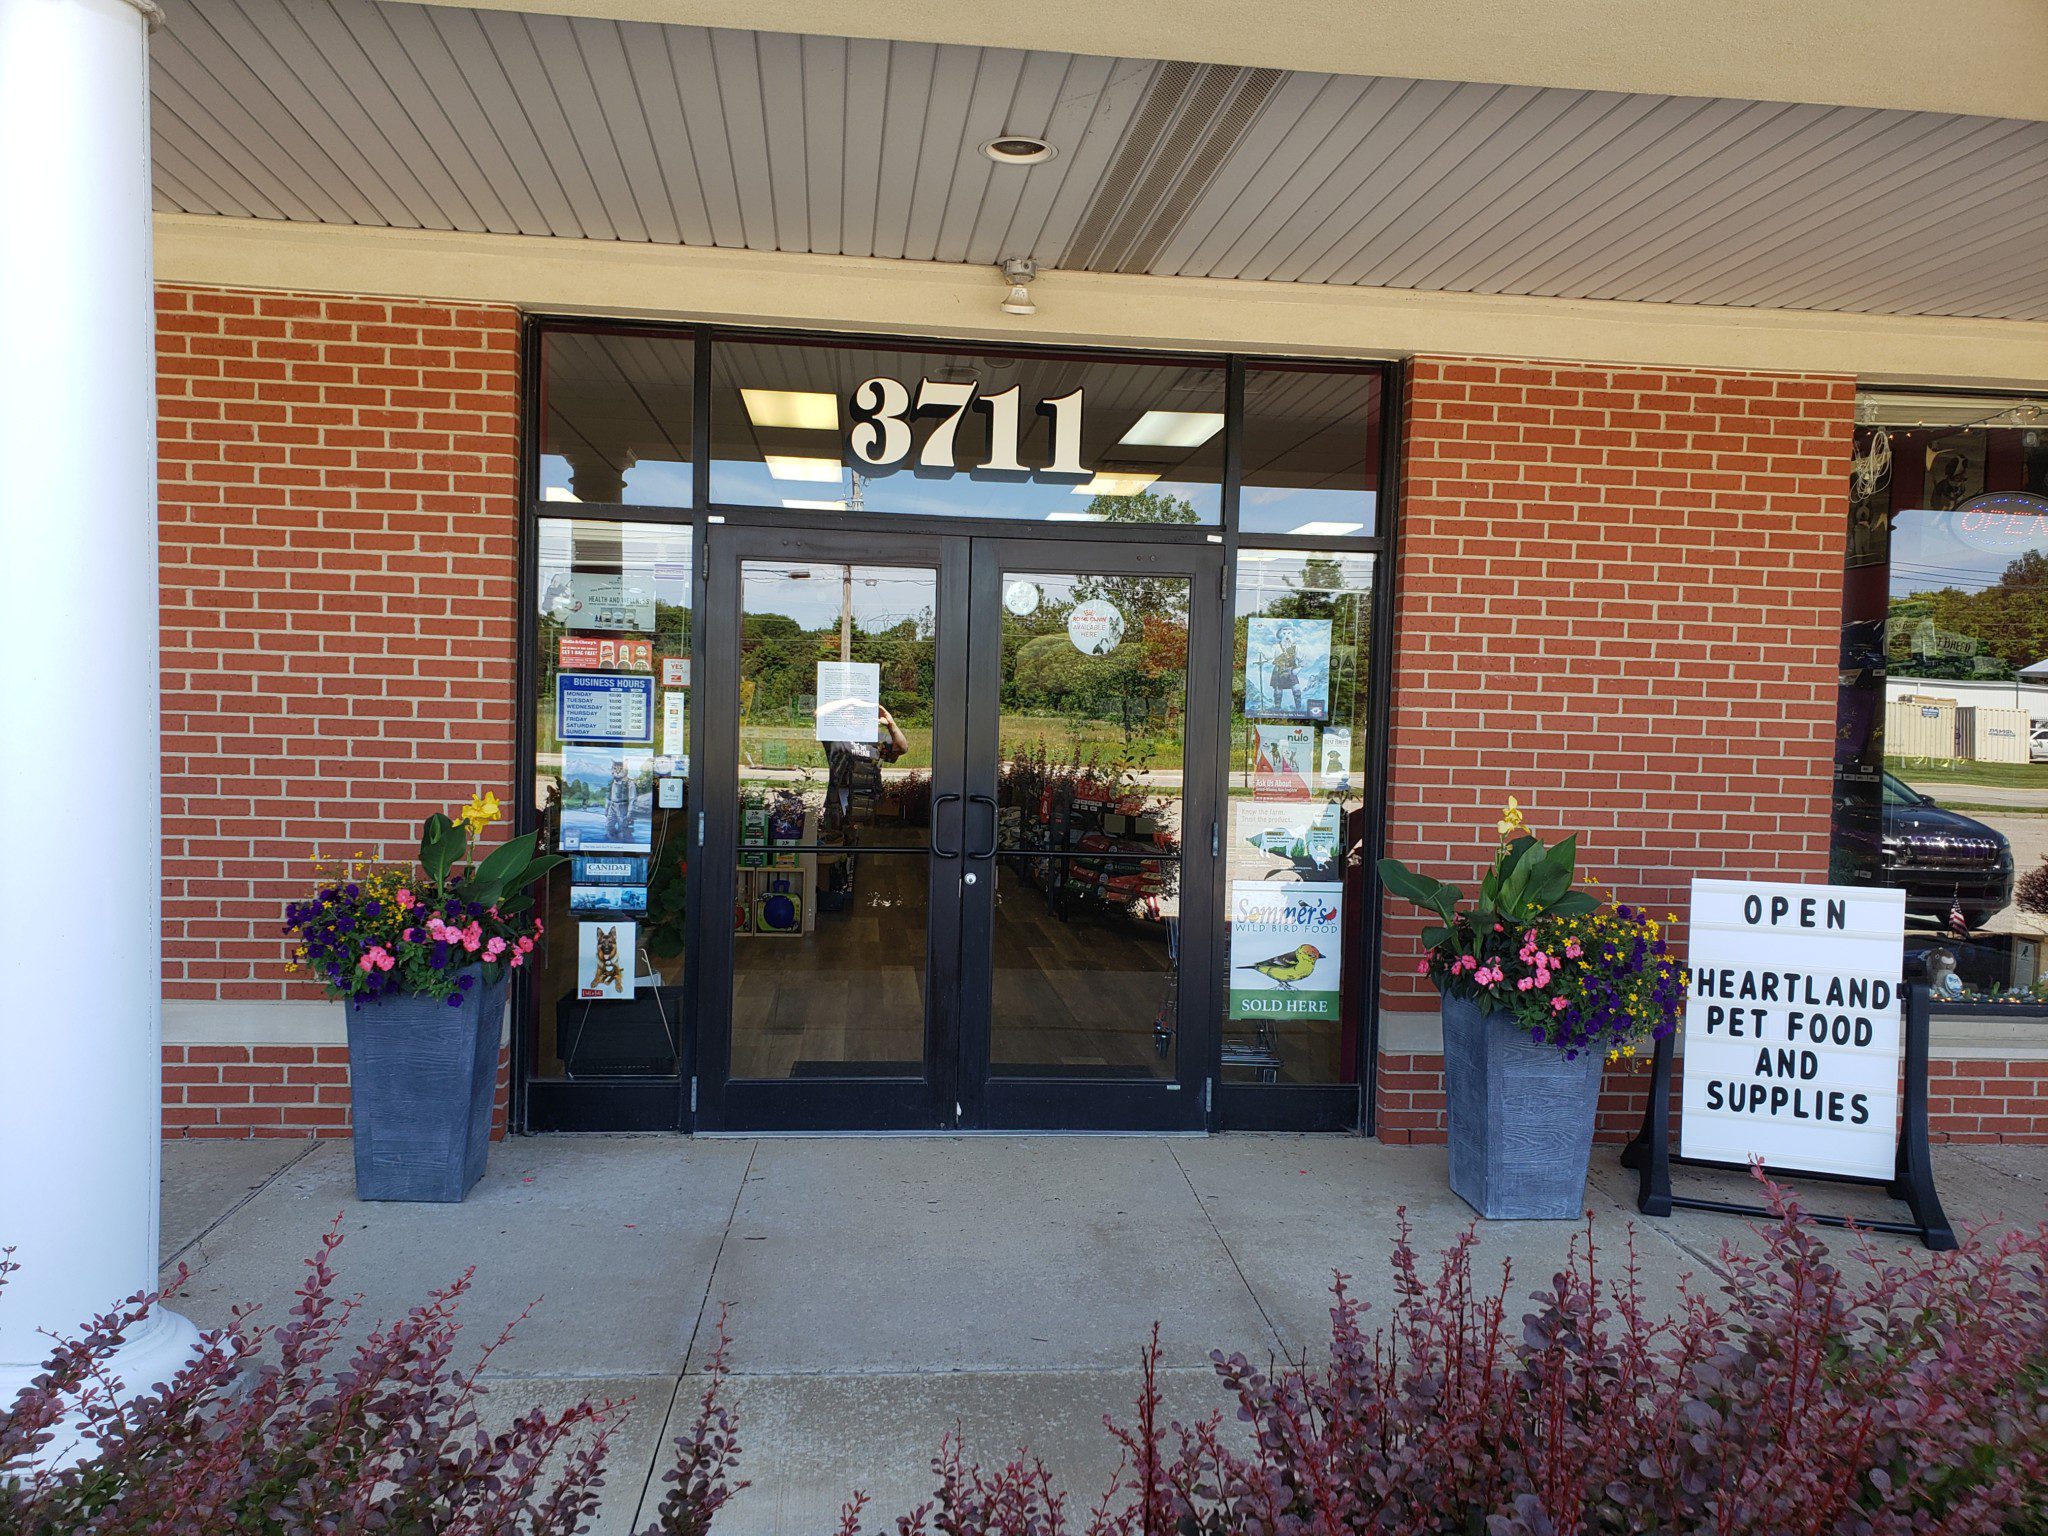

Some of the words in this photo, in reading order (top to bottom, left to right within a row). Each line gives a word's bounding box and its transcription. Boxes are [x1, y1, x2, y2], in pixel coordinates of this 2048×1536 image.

[848, 376, 1096, 482] 3711
[588, 595, 608, 604] HEALTH
[609, 596, 620, 604] AND
[573, 677, 615, 688] BUSINESS
[616, 679, 646, 689] HOURS
[1287, 734, 1309, 743] nulo
[1275, 779, 1292, 788] About
[1241, 808, 1258, 816] Know
[1258, 808, 1268, 816] the
[588, 863, 630, 871] CANIDAE
[1236, 898, 1327, 925] Sommer's
[1744, 894, 1846, 930] OPEN
[1235, 923, 1266, 933] WILD
[1271, 924, 1298, 933] BIRD
[1304, 925, 1338, 934] FOOD
[1697, 967, 1891, 1010] HEARTLAND
[1241, 999, 1283, 1012] SOLD
[1285, 1000, 1328, 1013] HERE
[1707, 1005, 1768, 1039] PET
[1787, 1011, 1873, 1047] FOOD
[1755, 1047, 1818, 1080] AND
[1706, 1080, 1869, 1125] SUPPLIES
